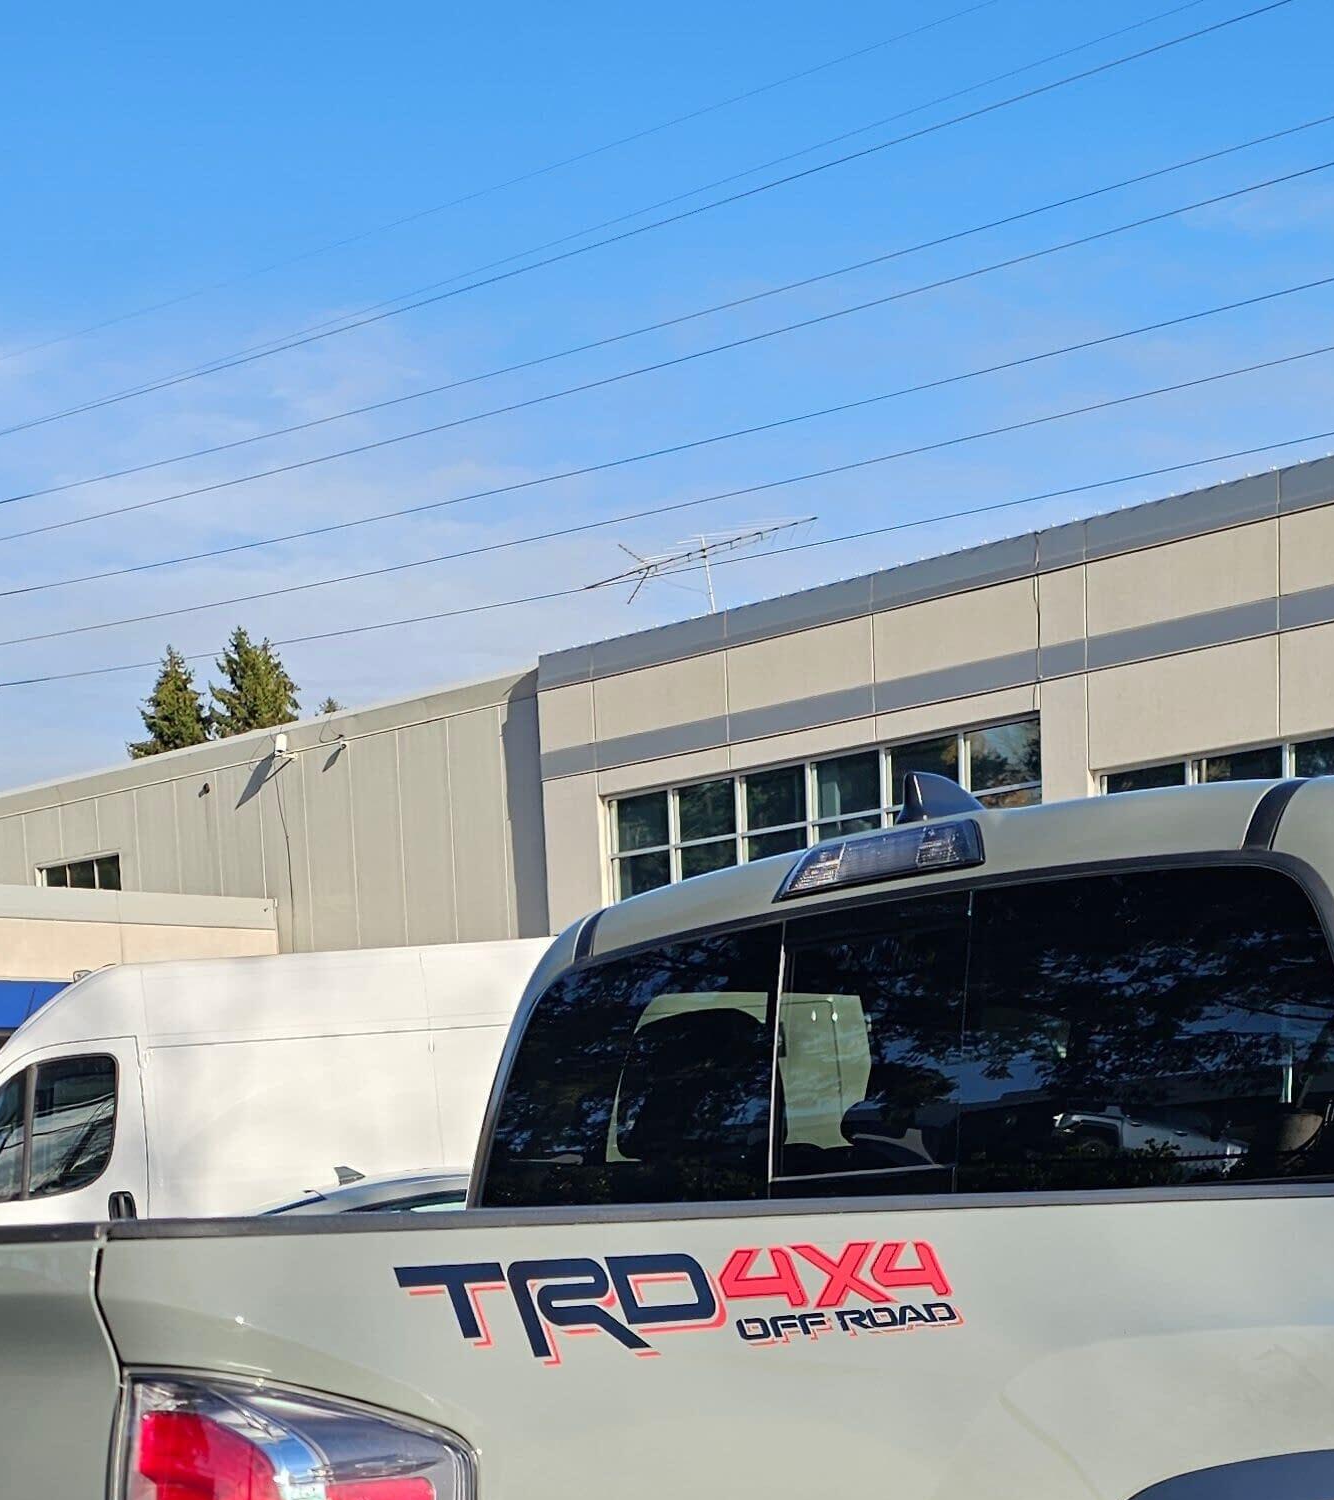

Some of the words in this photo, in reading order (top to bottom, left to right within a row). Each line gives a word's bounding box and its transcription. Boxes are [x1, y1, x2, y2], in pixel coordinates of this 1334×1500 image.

[393, 1252, 723, 1364] TRD
[718, 1240, 953, 1308] 4X4
[737, 1311, 831, 1345] OFF
[835, 1302, 963, 1336] ROAD
